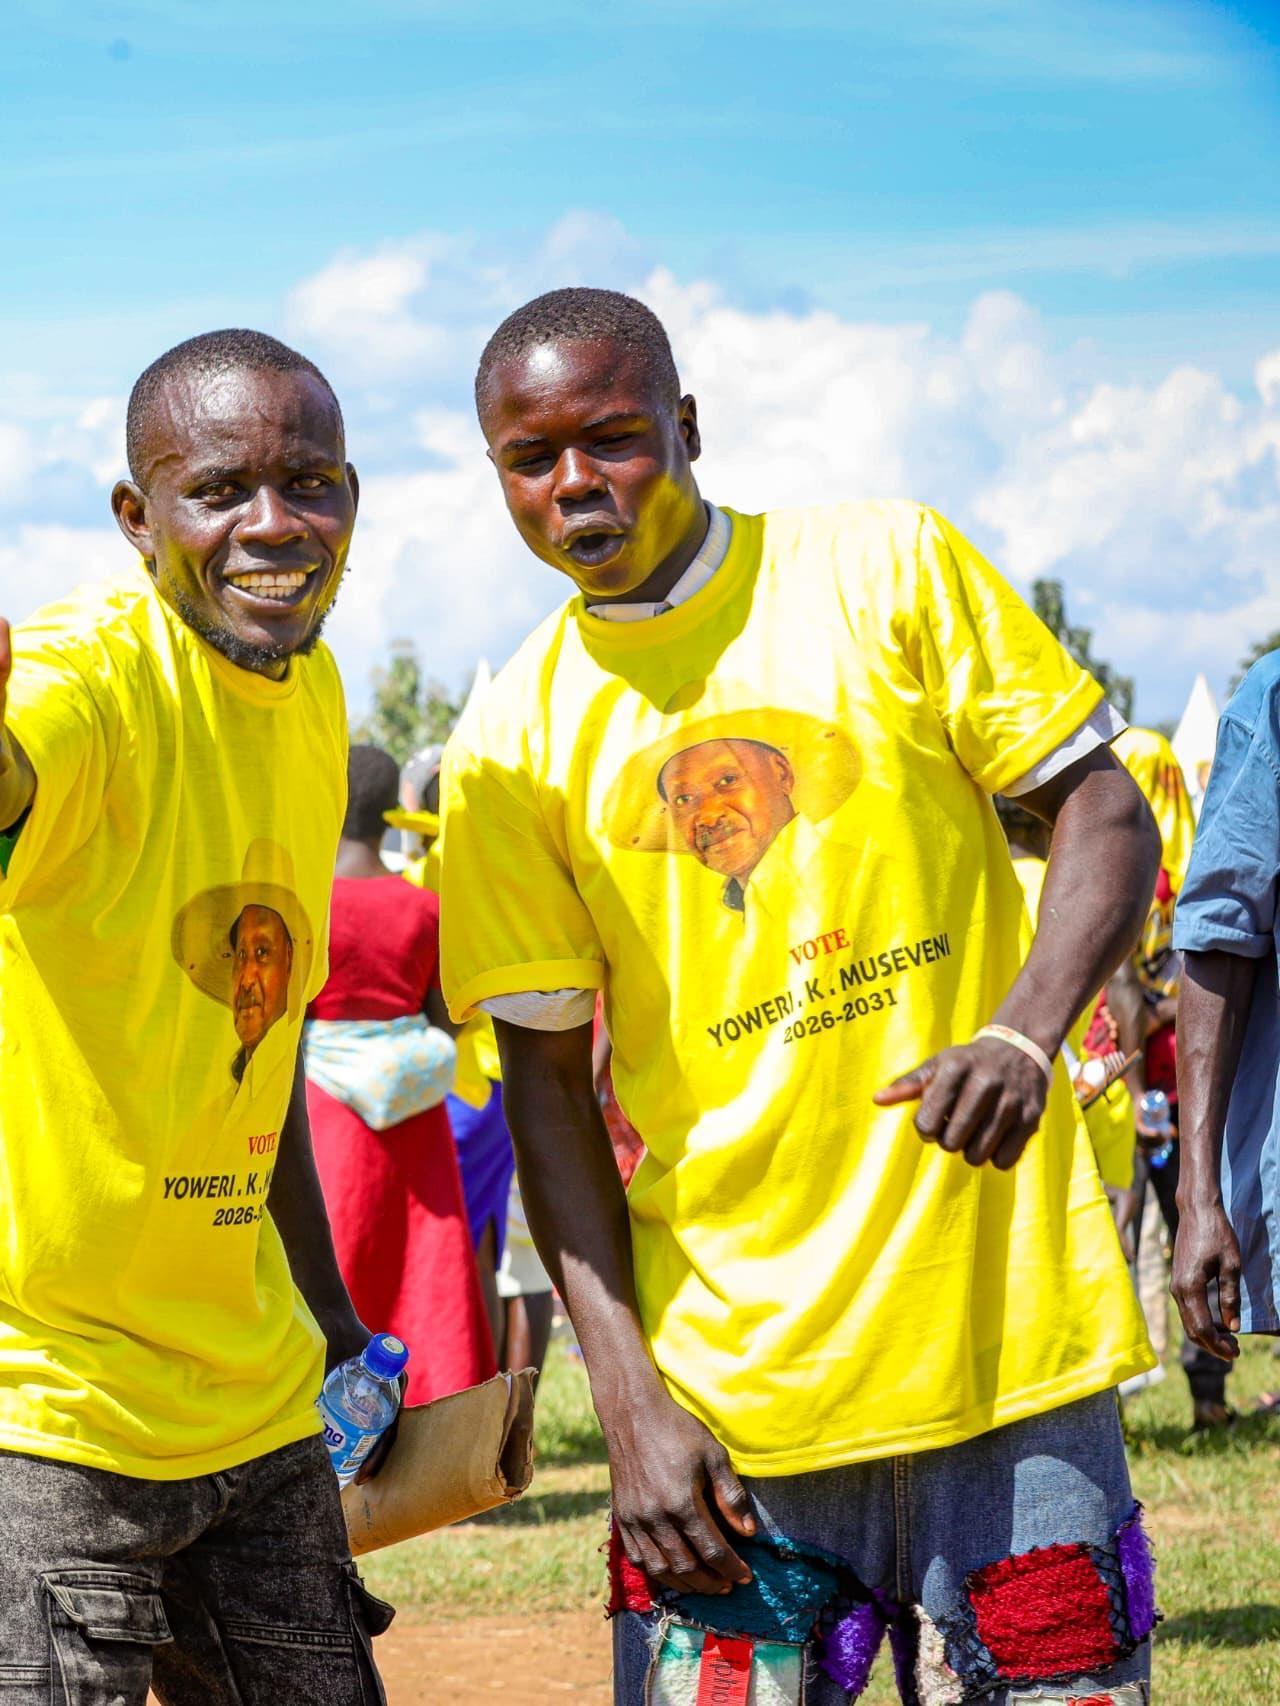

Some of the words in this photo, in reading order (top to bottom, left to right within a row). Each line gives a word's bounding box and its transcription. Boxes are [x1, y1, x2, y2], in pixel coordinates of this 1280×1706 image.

[789, 928, 852, 967] VOTE
[839, 932, 952, 992] MUSEVENI
[782, 987, 899, 1045] 2026-2031
[248, 1132, 278, 1156] VOTE
